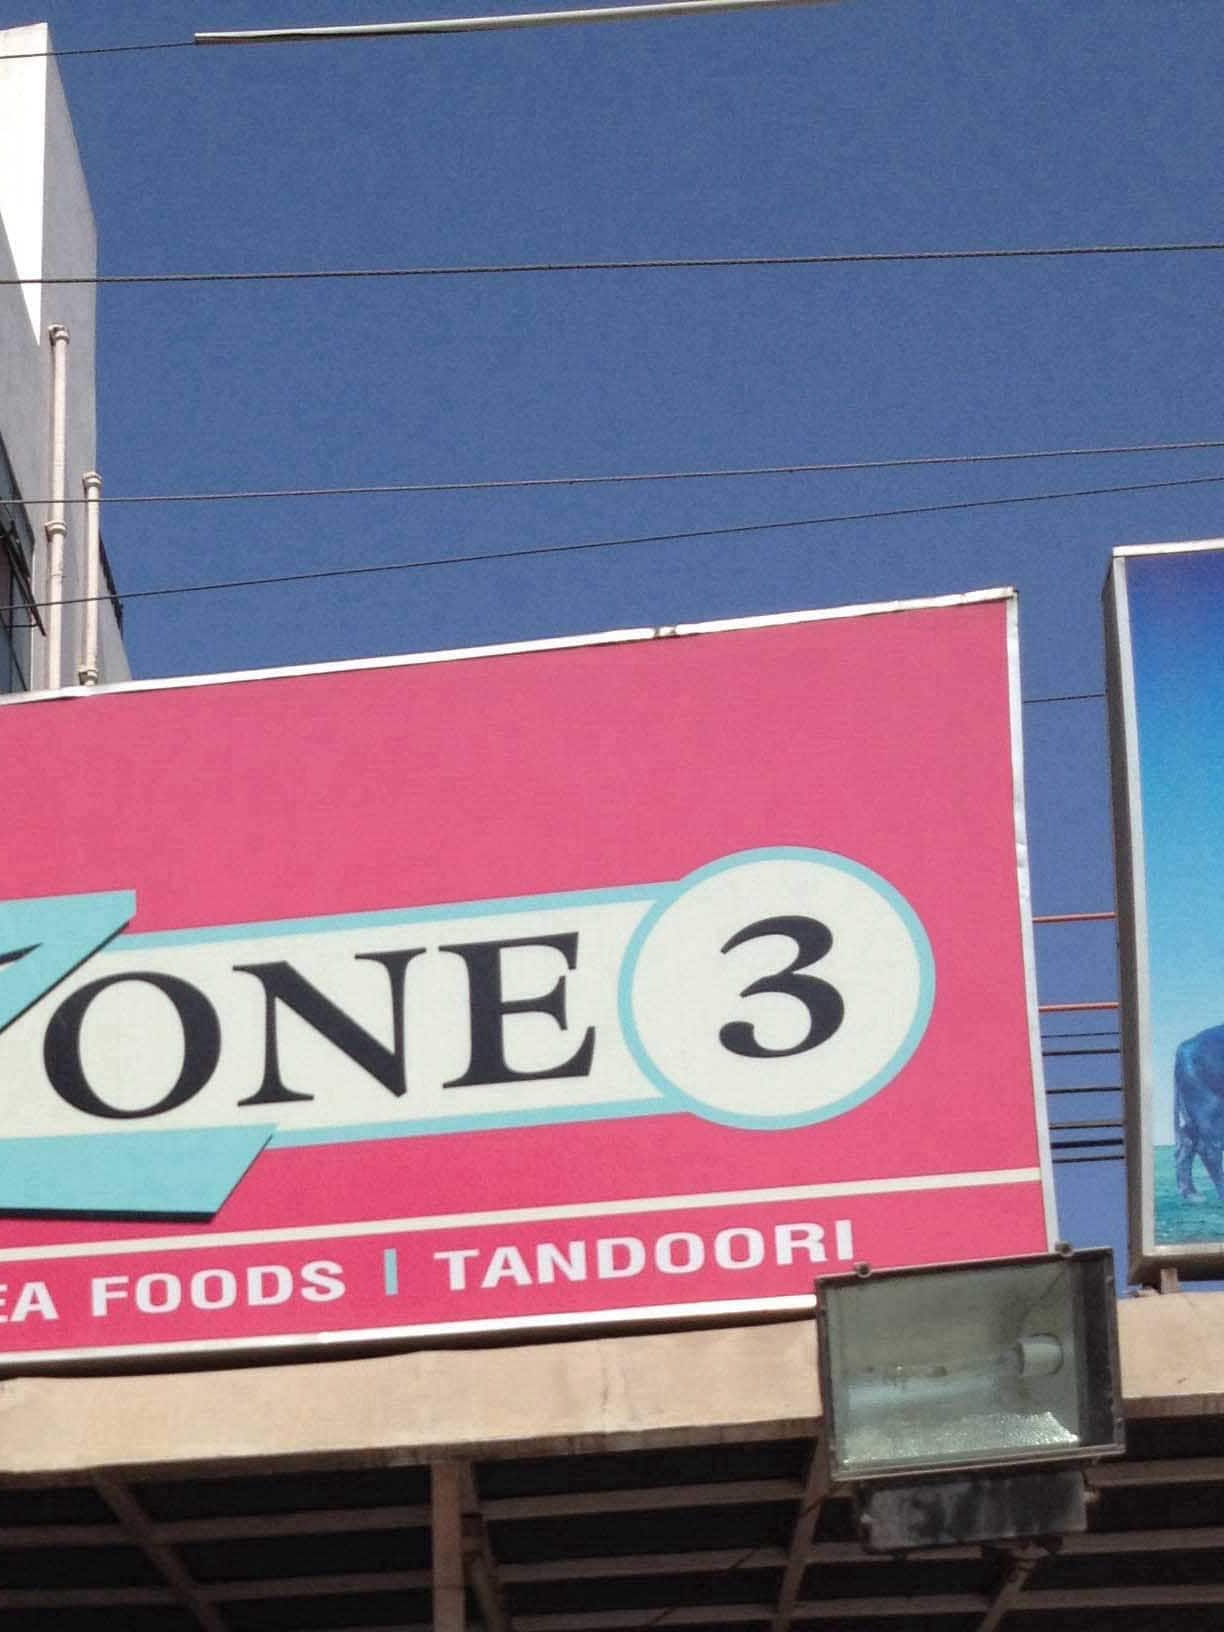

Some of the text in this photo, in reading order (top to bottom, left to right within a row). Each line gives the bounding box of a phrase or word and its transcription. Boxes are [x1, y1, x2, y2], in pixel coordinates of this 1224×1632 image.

[717, 914, 845, 1059] 3
[90, 1259, 346, 1318] FOODS
[434, 1218, 854, 1294] TANDOORI
